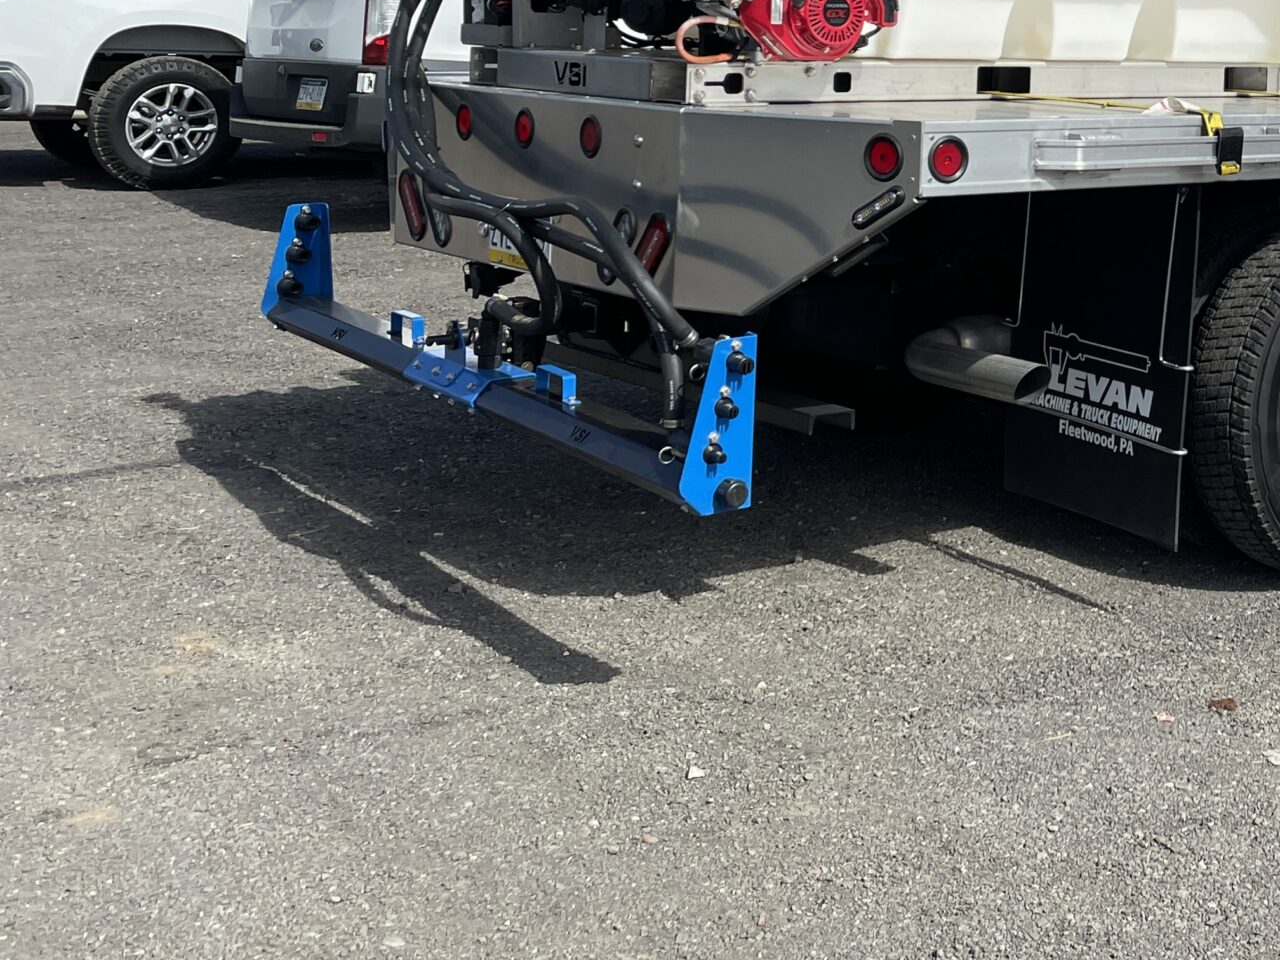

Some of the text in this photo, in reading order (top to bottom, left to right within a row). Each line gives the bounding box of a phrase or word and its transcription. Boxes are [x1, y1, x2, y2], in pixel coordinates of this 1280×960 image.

[826, 9, 847, 18] GX
[553, 61, 587, 87] VSI
[1049, 364, 1154, 418] LEVAN
[1059, 418, 1134, 456] Fleetwood, PA
[1072, 401, 1079, 417] &
[1081, 403, 1110, 426] TRUCK
[1110, 414, 1162, 442] EQUIPMENT
